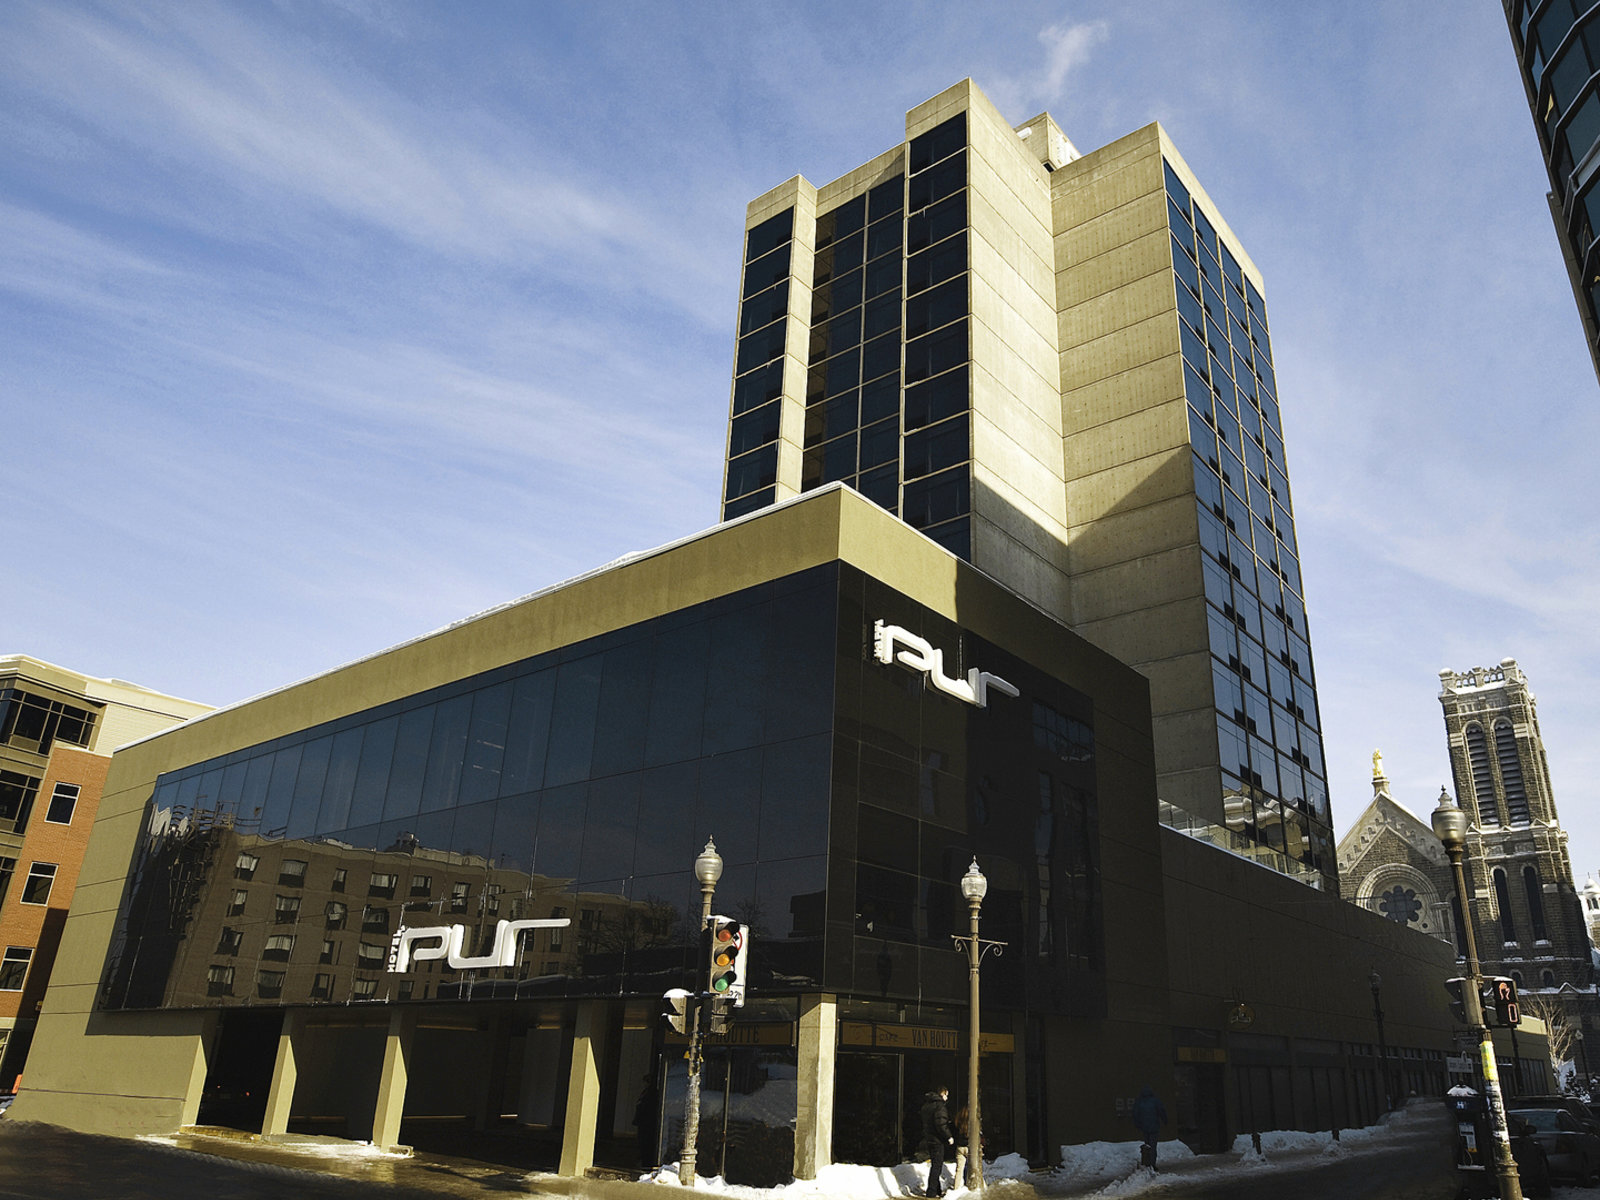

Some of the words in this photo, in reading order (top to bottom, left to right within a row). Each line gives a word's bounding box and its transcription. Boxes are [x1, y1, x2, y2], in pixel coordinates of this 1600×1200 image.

[880, 625, 1020, 708] pur
[395, 918, 571, 973] pur
[912, 1029, 928, 1047] VAN
